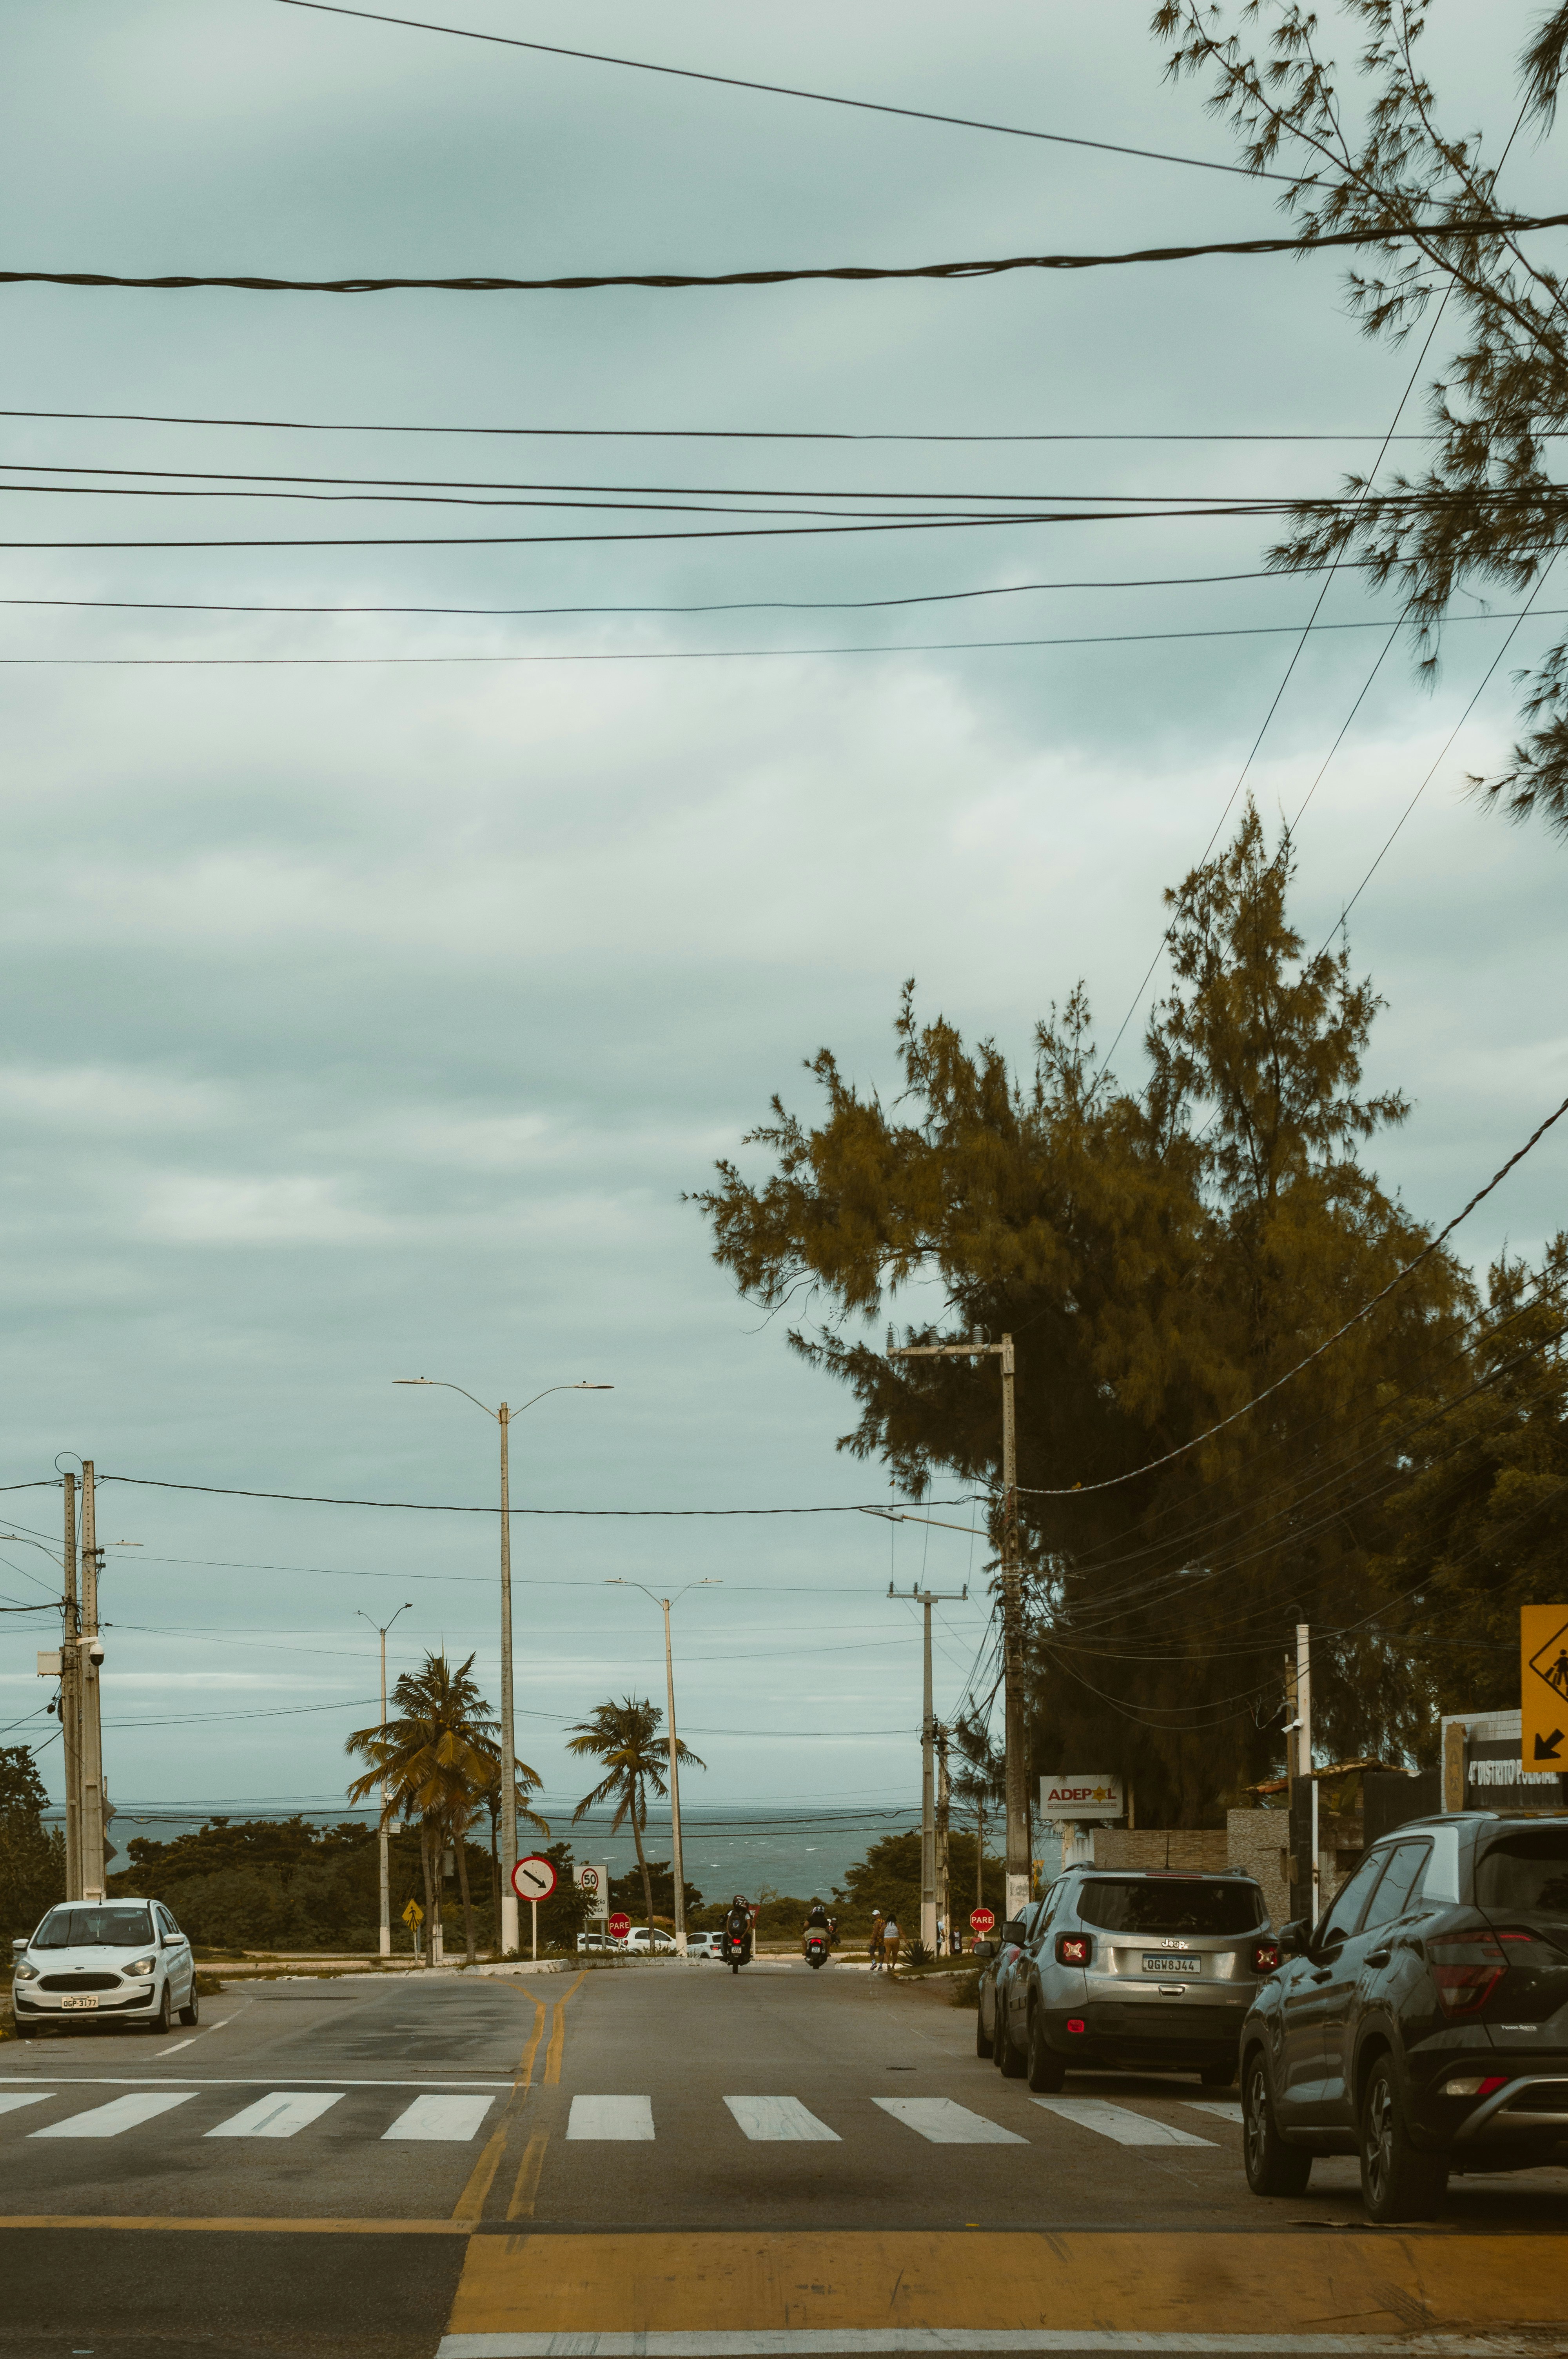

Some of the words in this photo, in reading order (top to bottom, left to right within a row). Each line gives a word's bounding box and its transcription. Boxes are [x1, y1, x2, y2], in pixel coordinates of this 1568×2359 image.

[1478, 1759, 1515, 1785] DISTRITO
[584, 1874, 596, 1885] 50
[610, 1921, 630, 1930] PARE
[1161, 1939, 1185, 1949] Jeep
[1148, 1959, 1194, 1971] QGW8J44
